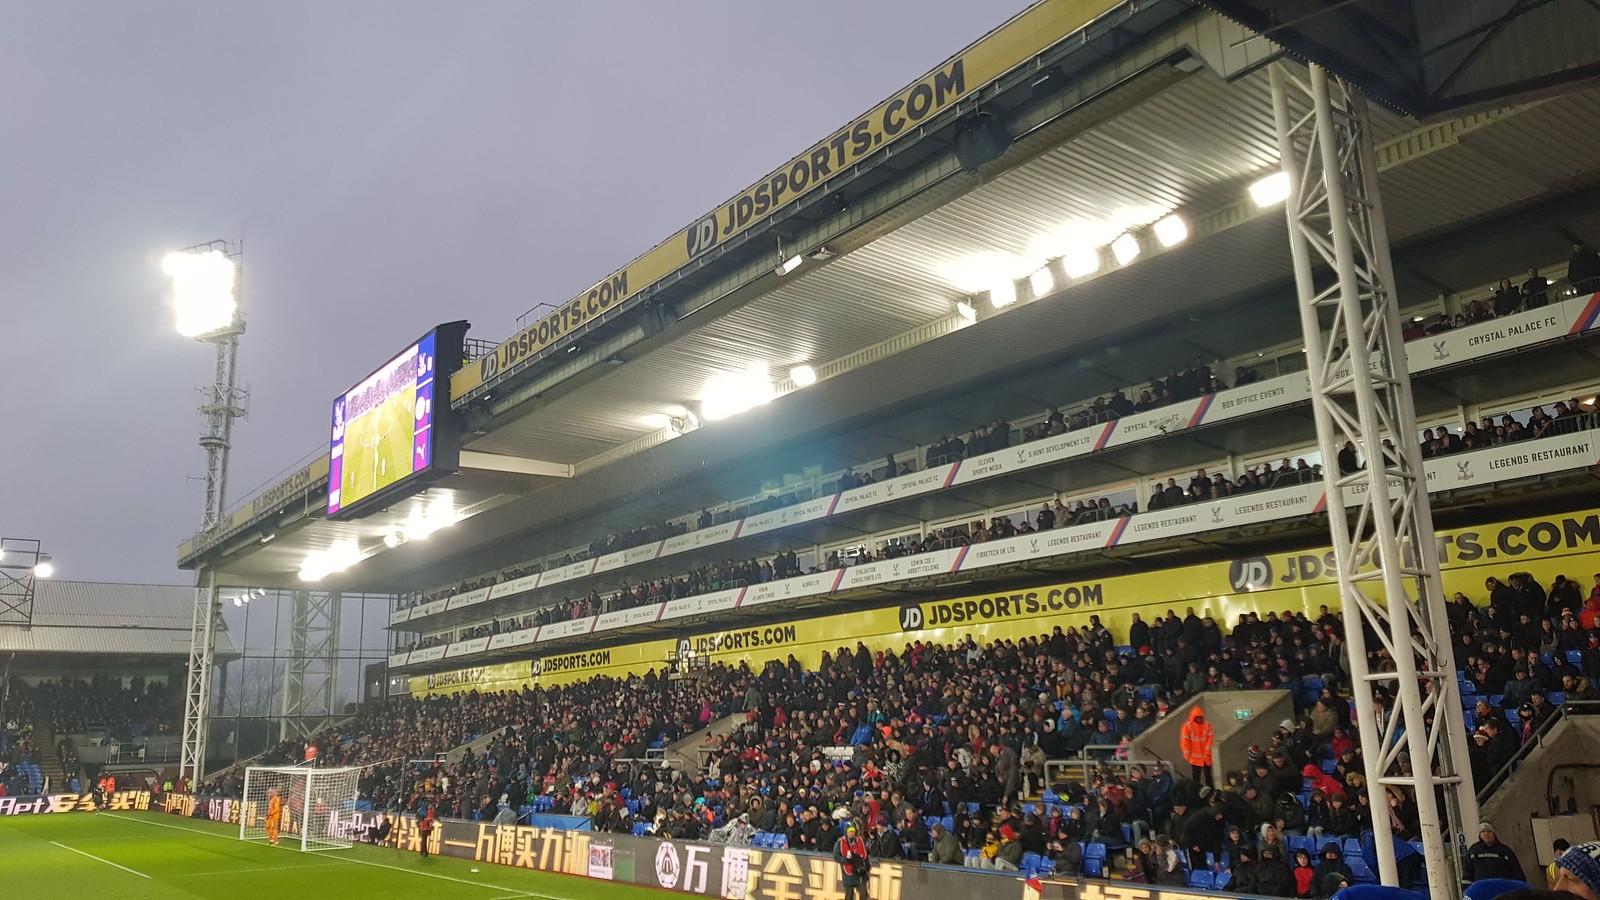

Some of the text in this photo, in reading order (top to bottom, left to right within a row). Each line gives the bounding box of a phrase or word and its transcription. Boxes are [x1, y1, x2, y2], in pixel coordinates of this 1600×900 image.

[723, 59, 965, 235] JDSPORTS.COM
[501, 271, 628, 368] JDSPORTS.COM
[1468, 317, 1557, 347] CRYSTAL PALACE FC
[1222, 387, 1285, 410] BOX OFFICE EVENTS
[1124, 422, 1148, 433] CRYSTAL
[1046, 439, 1081, 454] DEVELOPMENT
[1081, 436, 1091, 446] LTD
[1489, 443, 1590, 470] LEGENDS RESTAURANT
[978, 457, 995, 467] ELEVEN
[1235, 496, 1308, 515] LEGENDS RESTAURANT
[1134, 515, 1197, 533] LEGENDS RESTAURANT
[1047, 531, 1102, 547] LEGENDS RESTAURANT
[1235, 514, 1600, 588] JD JDSTS.COM
[902, 583, 1103, 629] JD JDSPORTS.COM
[695, 625, 796, 653] JDSPORTS.COM
[543, 650, 611, 672] JDSPORTS.COM
